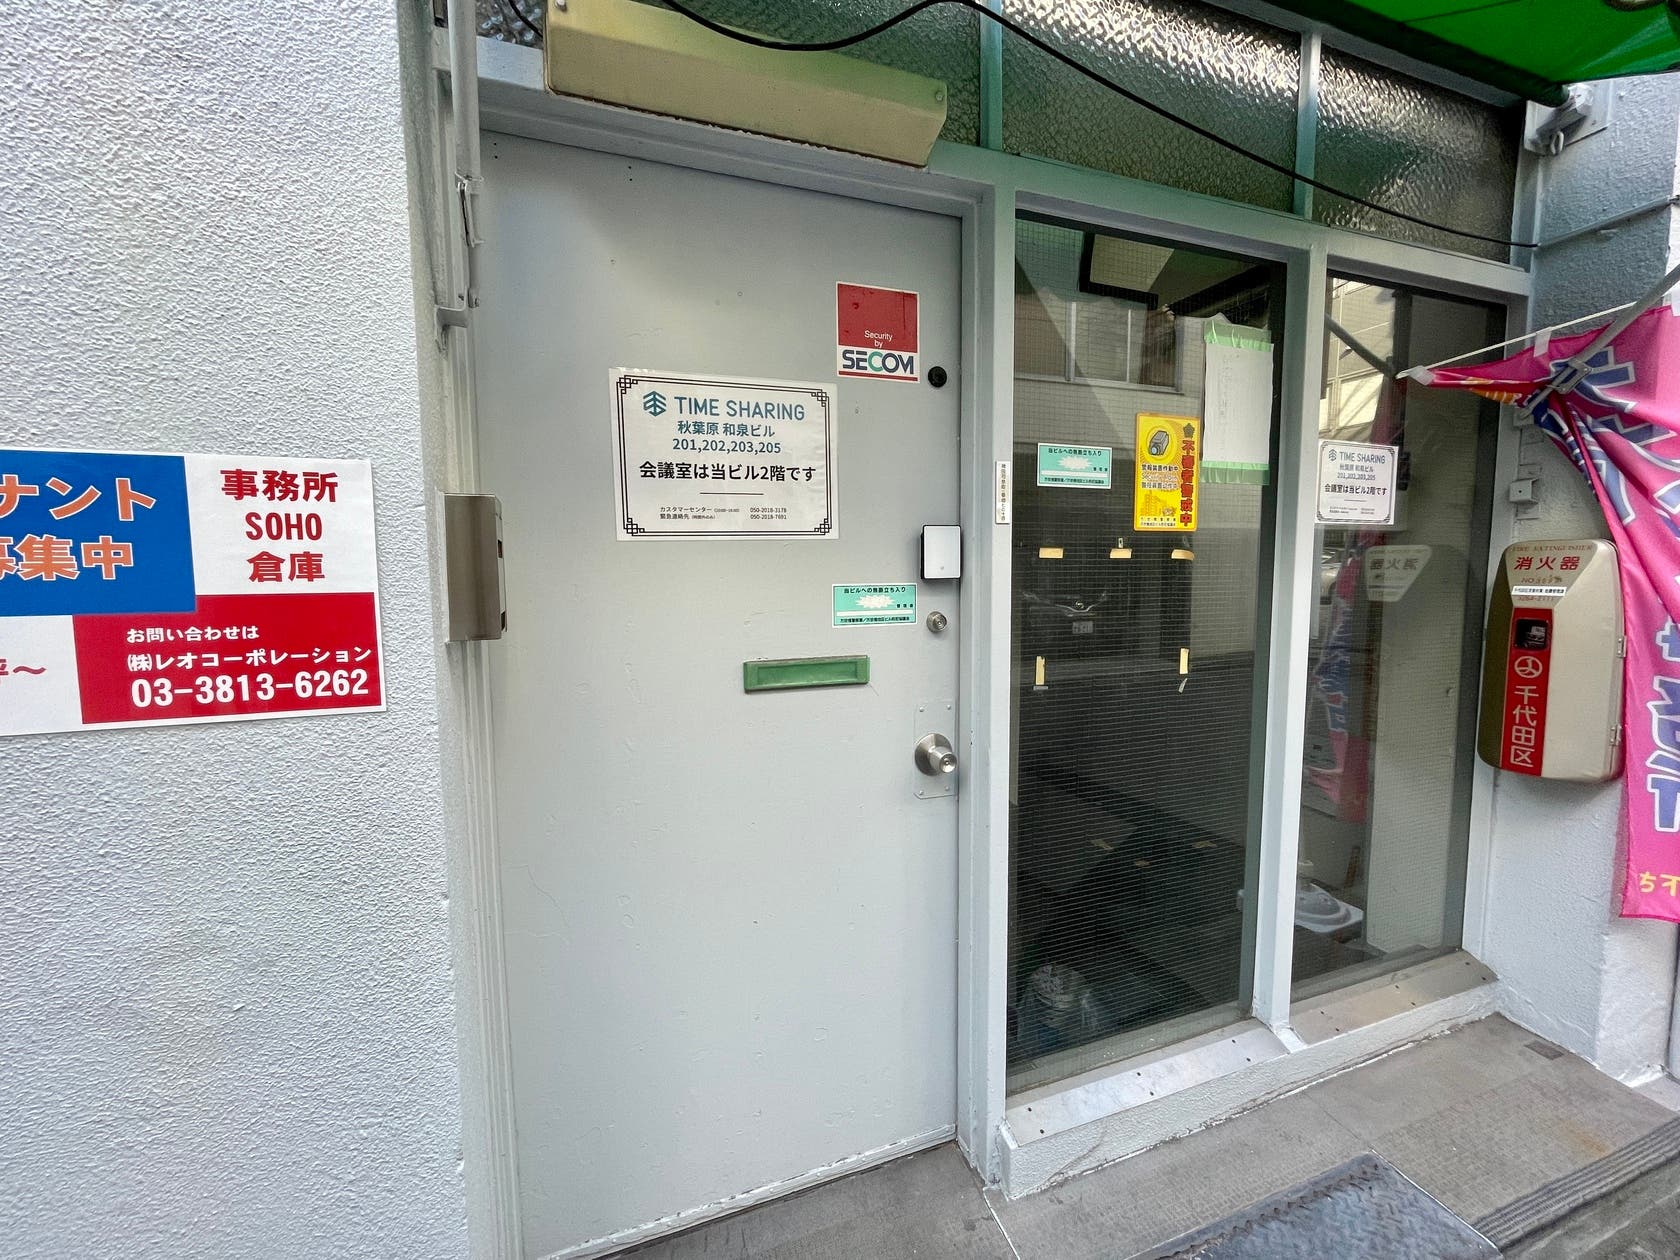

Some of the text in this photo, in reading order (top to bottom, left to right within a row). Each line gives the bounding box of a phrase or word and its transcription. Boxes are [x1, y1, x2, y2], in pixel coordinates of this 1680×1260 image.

[864, 330, 893, 342] Security
[874, 340, 883, 348] by
[842, 349, 914, 375] SECOM
[674, 396, 805, 420] TIME SHARING
[677, 420, 775, 437] 秋葉原 和泉ビル
[672, 438, 781, 455] 201,202,203,205
[1339, 451, 1386, 464] TIME SHARING
[639, 461, 816, 482] 会議室は当ビル2階です
[220, 468, 339, 503] 事務所
[245, 512, 323, 541] SOHO
[247, 550, 326, 583] 倉庫
[1514, 556, 1580, 571] 消火器
[126, 625, 260, 644] お問い合わせは
[131, 668, 370, 708] 03-3813-6262
[1509, 685, 1540, 768] 千代田区
